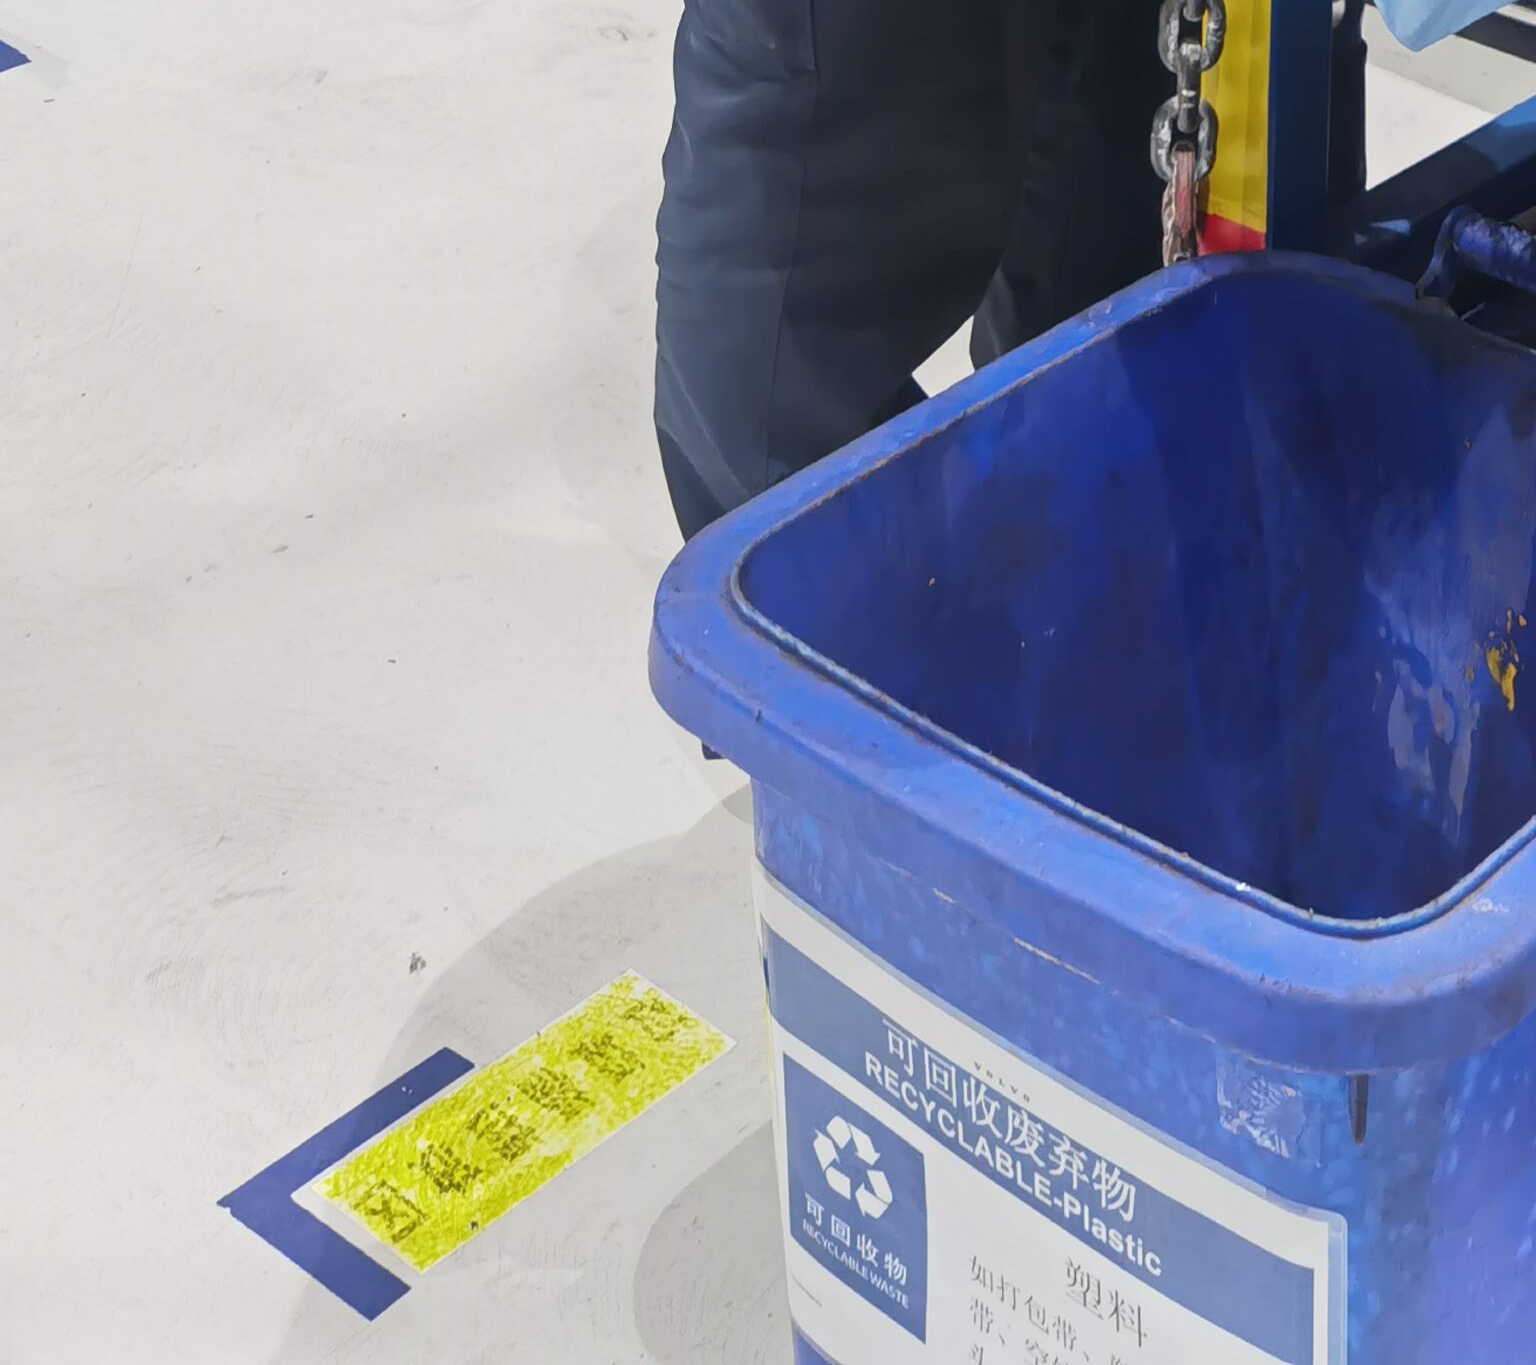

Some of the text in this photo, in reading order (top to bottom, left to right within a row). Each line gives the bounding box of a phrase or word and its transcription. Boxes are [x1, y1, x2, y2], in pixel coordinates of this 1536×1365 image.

[864, 1050, 1162, 1277] RECYCLABLE-Plastic
[882, 1018, 1137, 1223] 可回收废弃物
[802, 1218, 909, 1310] RECYCLABLE WASTE
[804, 1191, 907, 1287] 可回收物
[1065, 1255, 1147, 1349] 塑料
